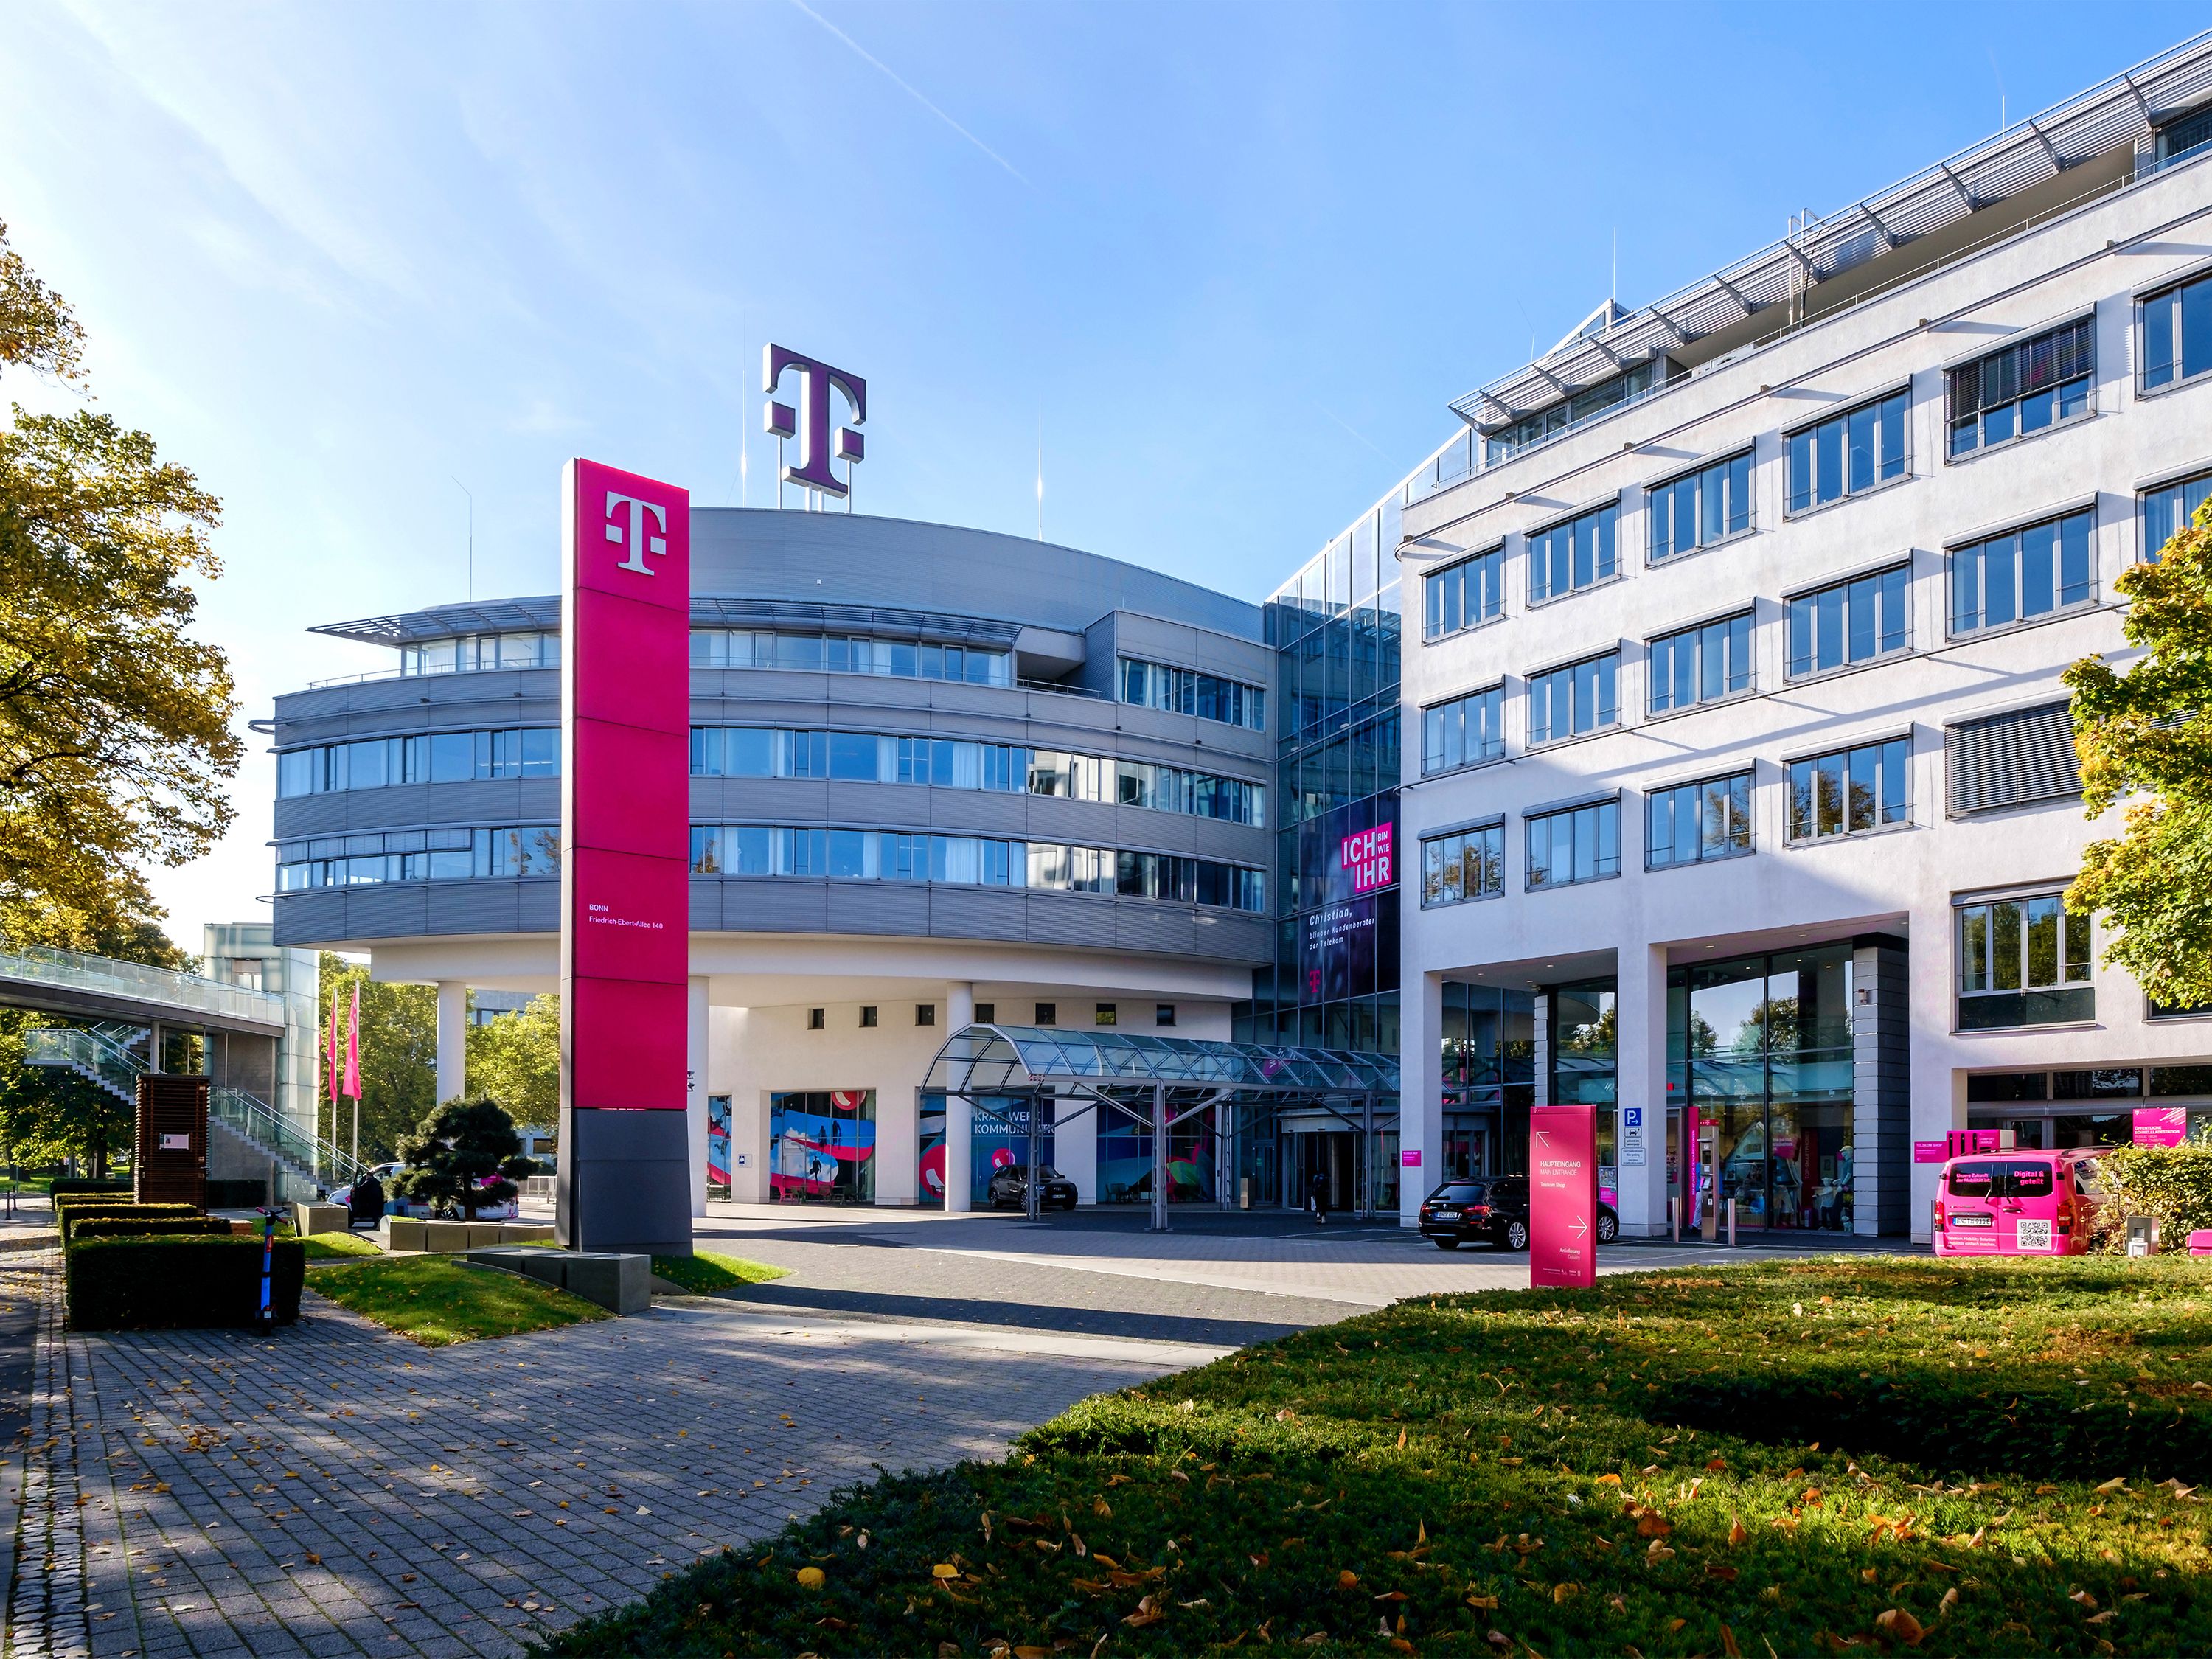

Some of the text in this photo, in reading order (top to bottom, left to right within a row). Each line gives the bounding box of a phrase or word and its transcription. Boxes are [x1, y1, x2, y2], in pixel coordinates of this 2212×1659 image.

[762, 342, 866, 499] T
[605, 490, 666, 576] T
[1377, 830, 1388, 842] BIN
[1343, 832, 1376, 866] ICH
[1377, 844, 1389, 854] WIE
[1357, 856, 1389, 888] IHR
[589, 904, 608, 912] BONN
[589, 916, 650, 928] Friedrich-Ebert-Allee
[1310, 908, 1352, 926] Christian,
[1332, 918, 1374, 933] Kundenberater
[1627, 1110, 1636, 1124] P
[2014, 1170, 2037, 1178] Digital
